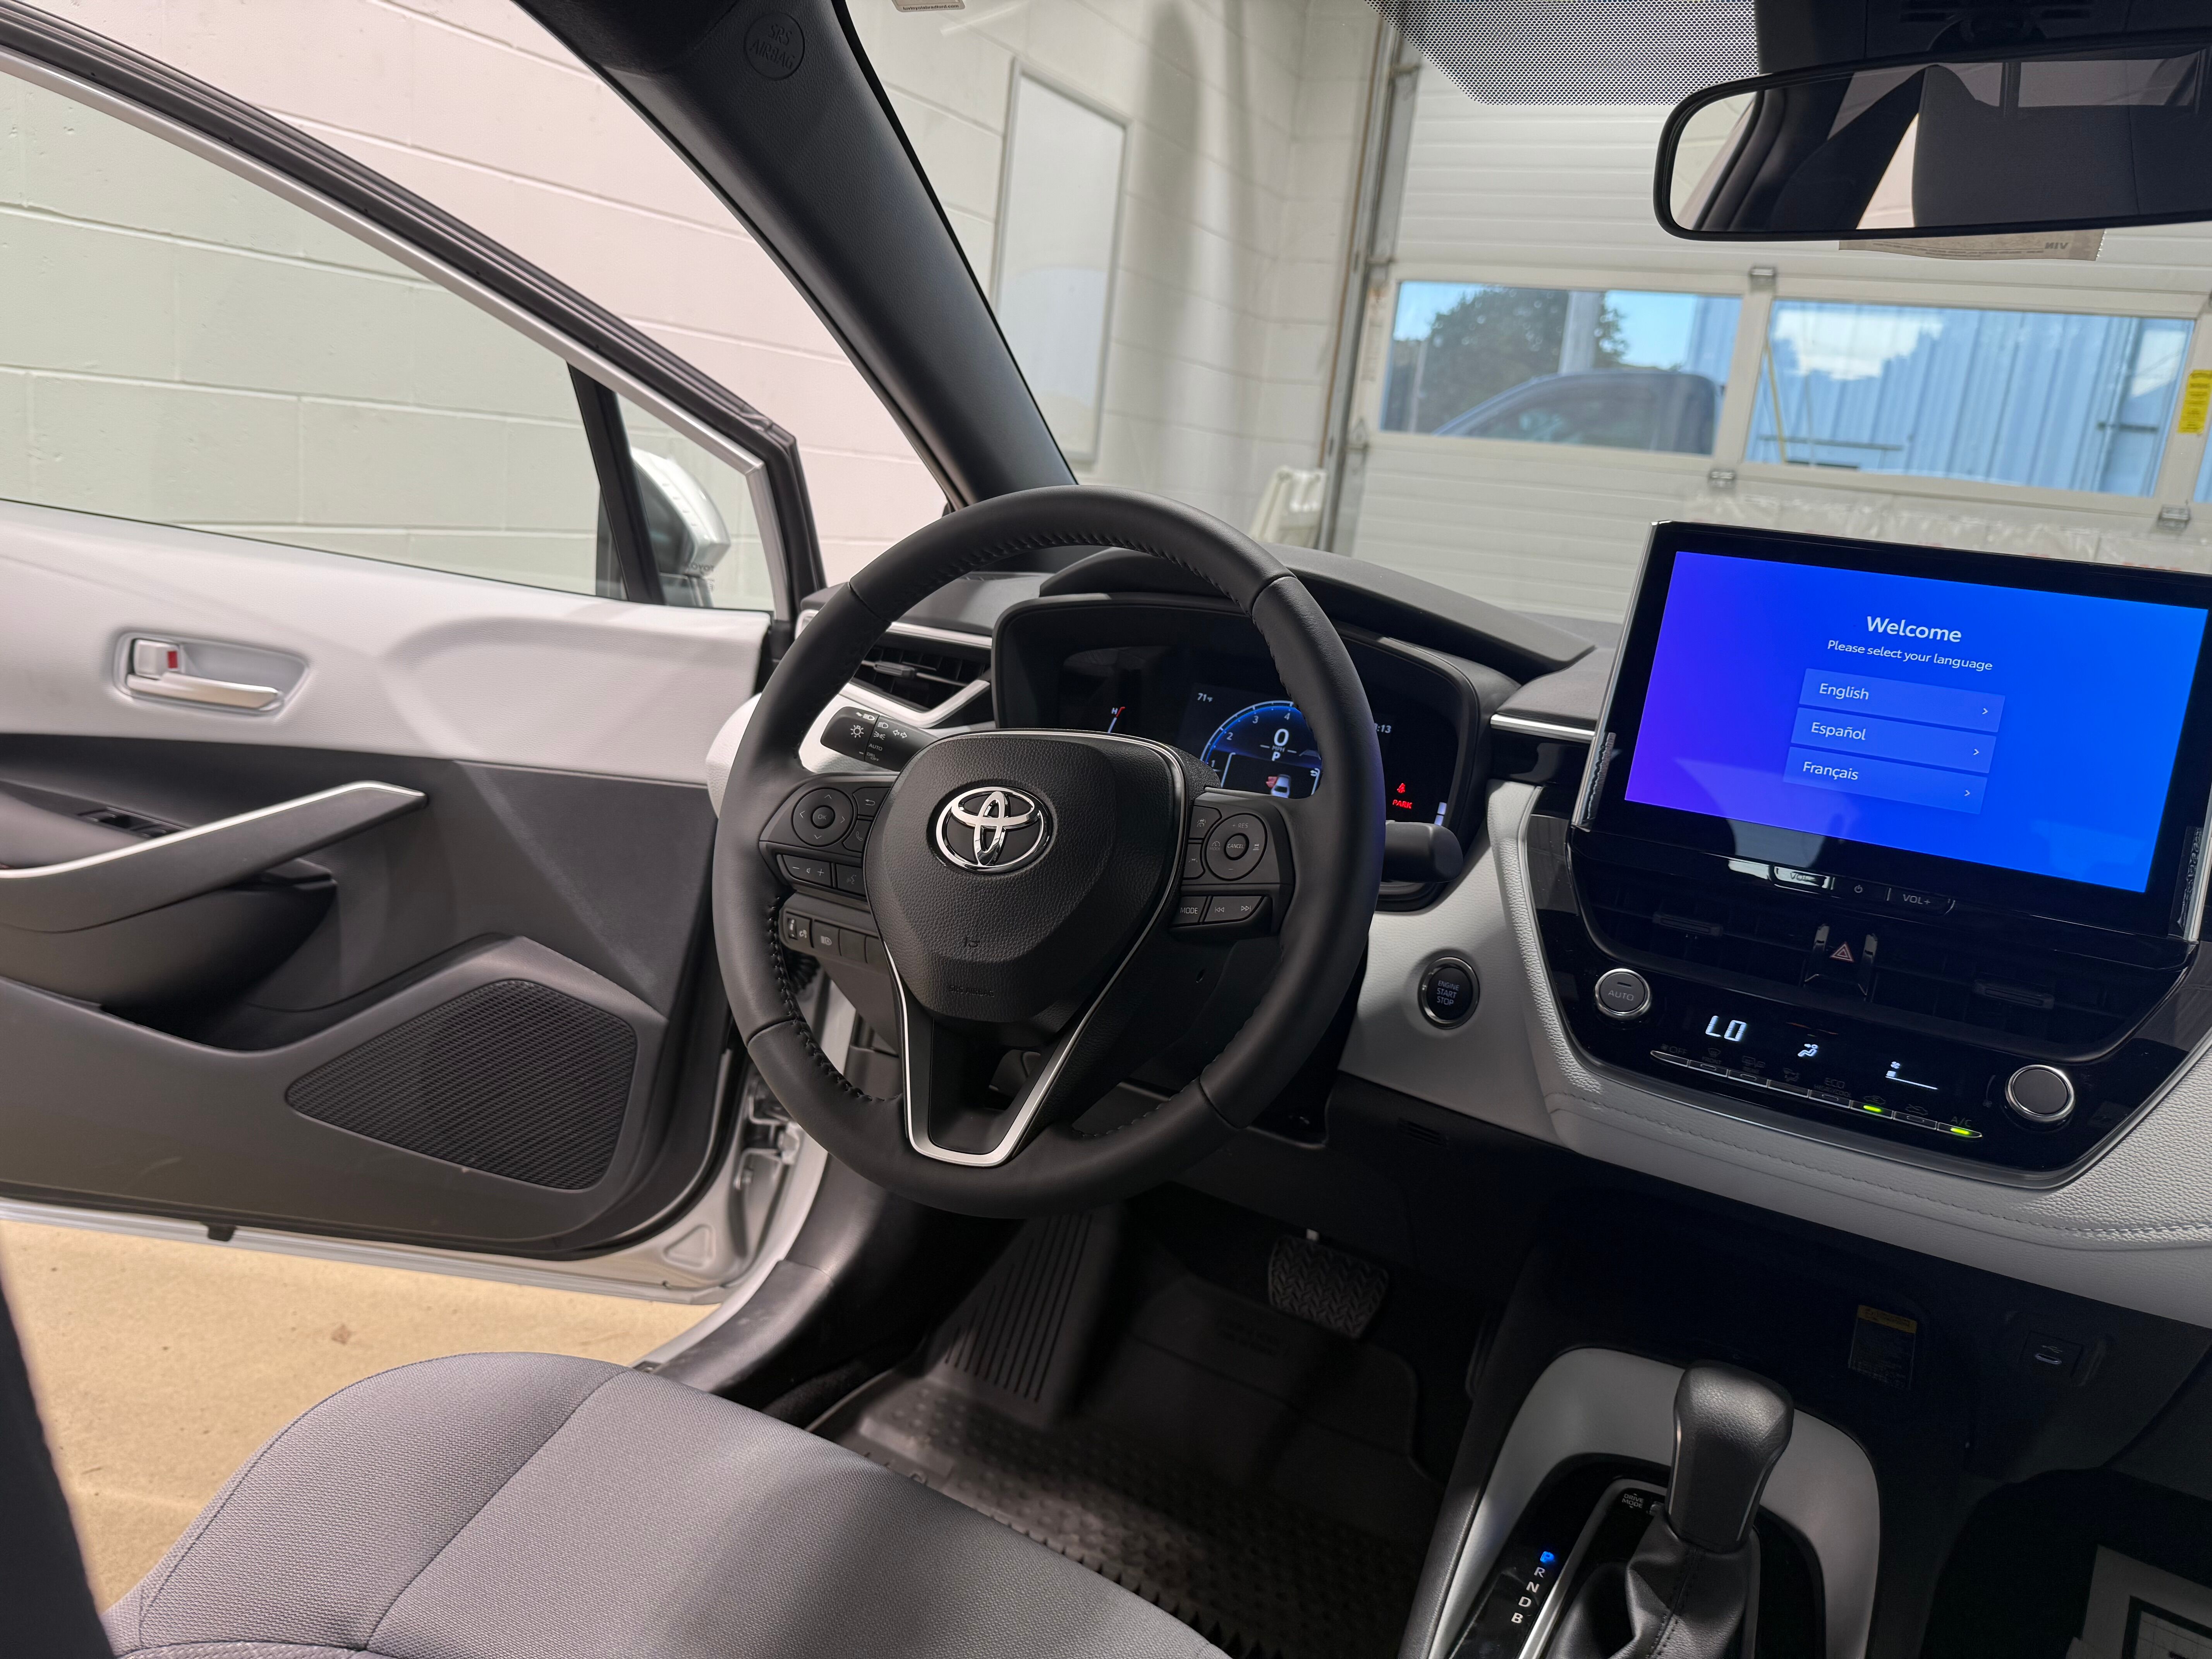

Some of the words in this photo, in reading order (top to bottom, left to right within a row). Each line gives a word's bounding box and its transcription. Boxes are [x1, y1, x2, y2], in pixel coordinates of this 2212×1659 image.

[768, 24, 792, 46] SRS
[749, 39, 795, 70] AIRBAG
[1867, 616, 1962, 642] Welcome
[1827, 640, 1865, 654] Please
[1867, 646, 1902, 659] select
[1903, 652, 1932, 662] your
[1934, 653, 1993, 672] language
[1819, 683, 1869, 700] English
[1252, 716, 1259, 724] 3
[1811, 722, 1866, 740] Español
[1274, 728, 1289, 746] 0
[1271, 752, 1281, 761] P
[1803, 761, 1858, 780] Français
[1393, 799, 1413, 809] PARK
[1903, 894, 1930, 905] VOL+
[1438, 980, 1460, 991] ENGINE
[1437, 988, 1457, 998] START
[1608, 990, 1634, 1001] AUTO
[1437, 996, 1454, 1005] STOP
[1705, 1015, 1747, 1041] LO
[1669, 1046, 1688, 1055] OFF
[1702, 1056, 1722, 1065] FRONT
[1951, 1116, 1972, 1127] A/C
[1622, 1498, 1643, 1508] MODE
[1624, 1493, 1644, 1503] DRIVE
[1540, 1551, 1554, 1563] P
[1534, 1567, 1545, 1578] R
[1526, 1582, 1539, 1593] N
[1518, 1596, 1531, 1607] D
[1511, 1613, 1523, 1623] B
